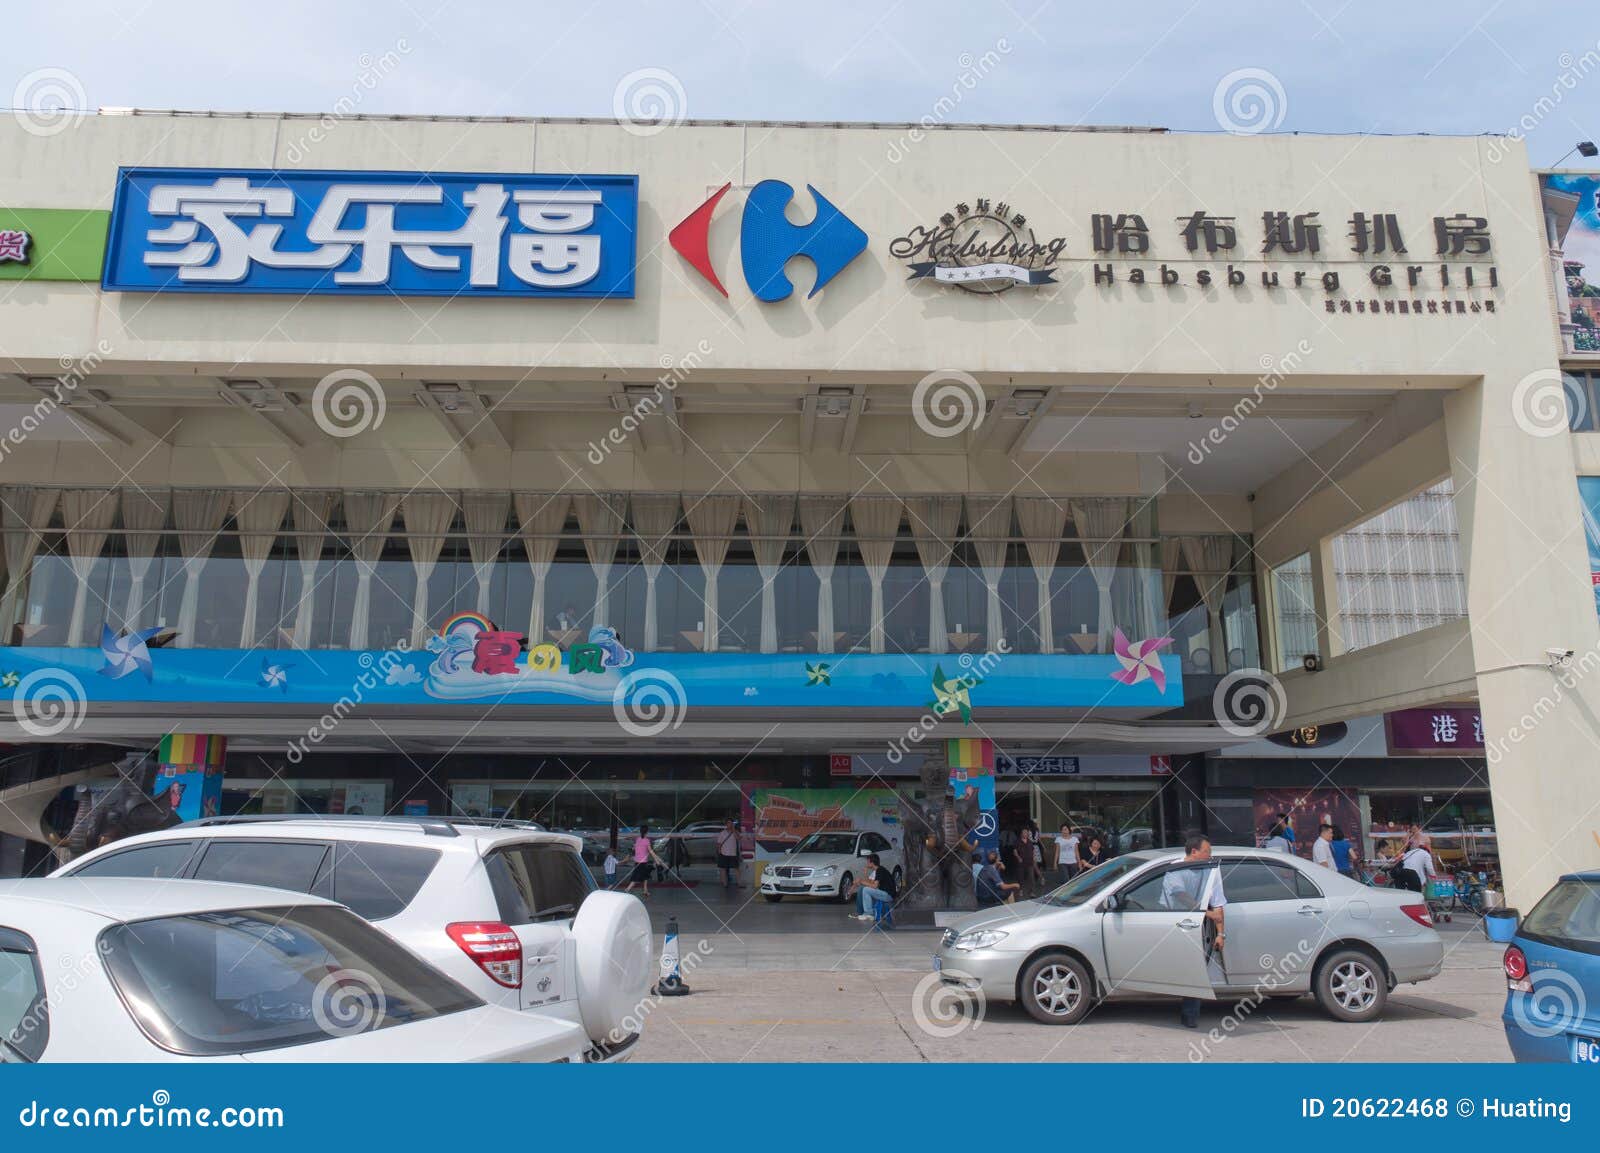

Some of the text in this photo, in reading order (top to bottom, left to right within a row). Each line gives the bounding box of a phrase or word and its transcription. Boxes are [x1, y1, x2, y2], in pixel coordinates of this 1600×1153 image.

[144, 177, 602, 288] 家乐福
[1091, 210, 1491, 255] 哈布斯扒房
[1094, 263, 1498, 291] Habsburg Grill
[1018, 757, 1076, 773] 家乐福
